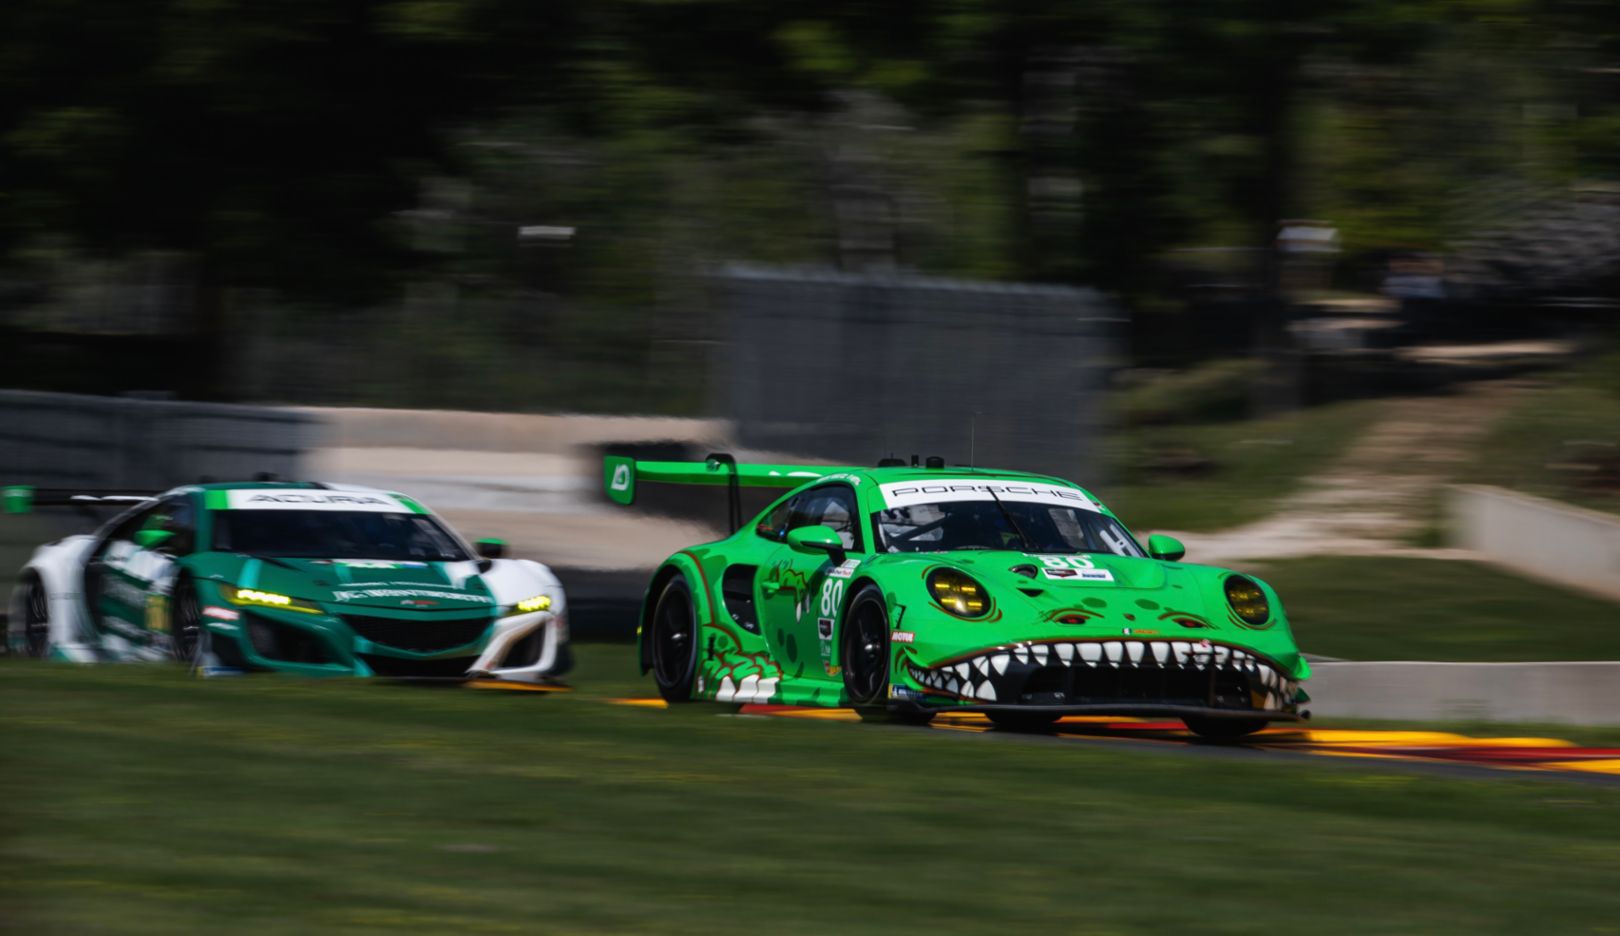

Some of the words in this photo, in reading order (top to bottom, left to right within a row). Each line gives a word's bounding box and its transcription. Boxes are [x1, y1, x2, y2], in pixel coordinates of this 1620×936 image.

[247, 494, 392, 505] ACURA
[892, 485, 1083, 502] PORSCHE
[1038, 553, 1095, 569] 80
[821, 578, 843, 618] 80
